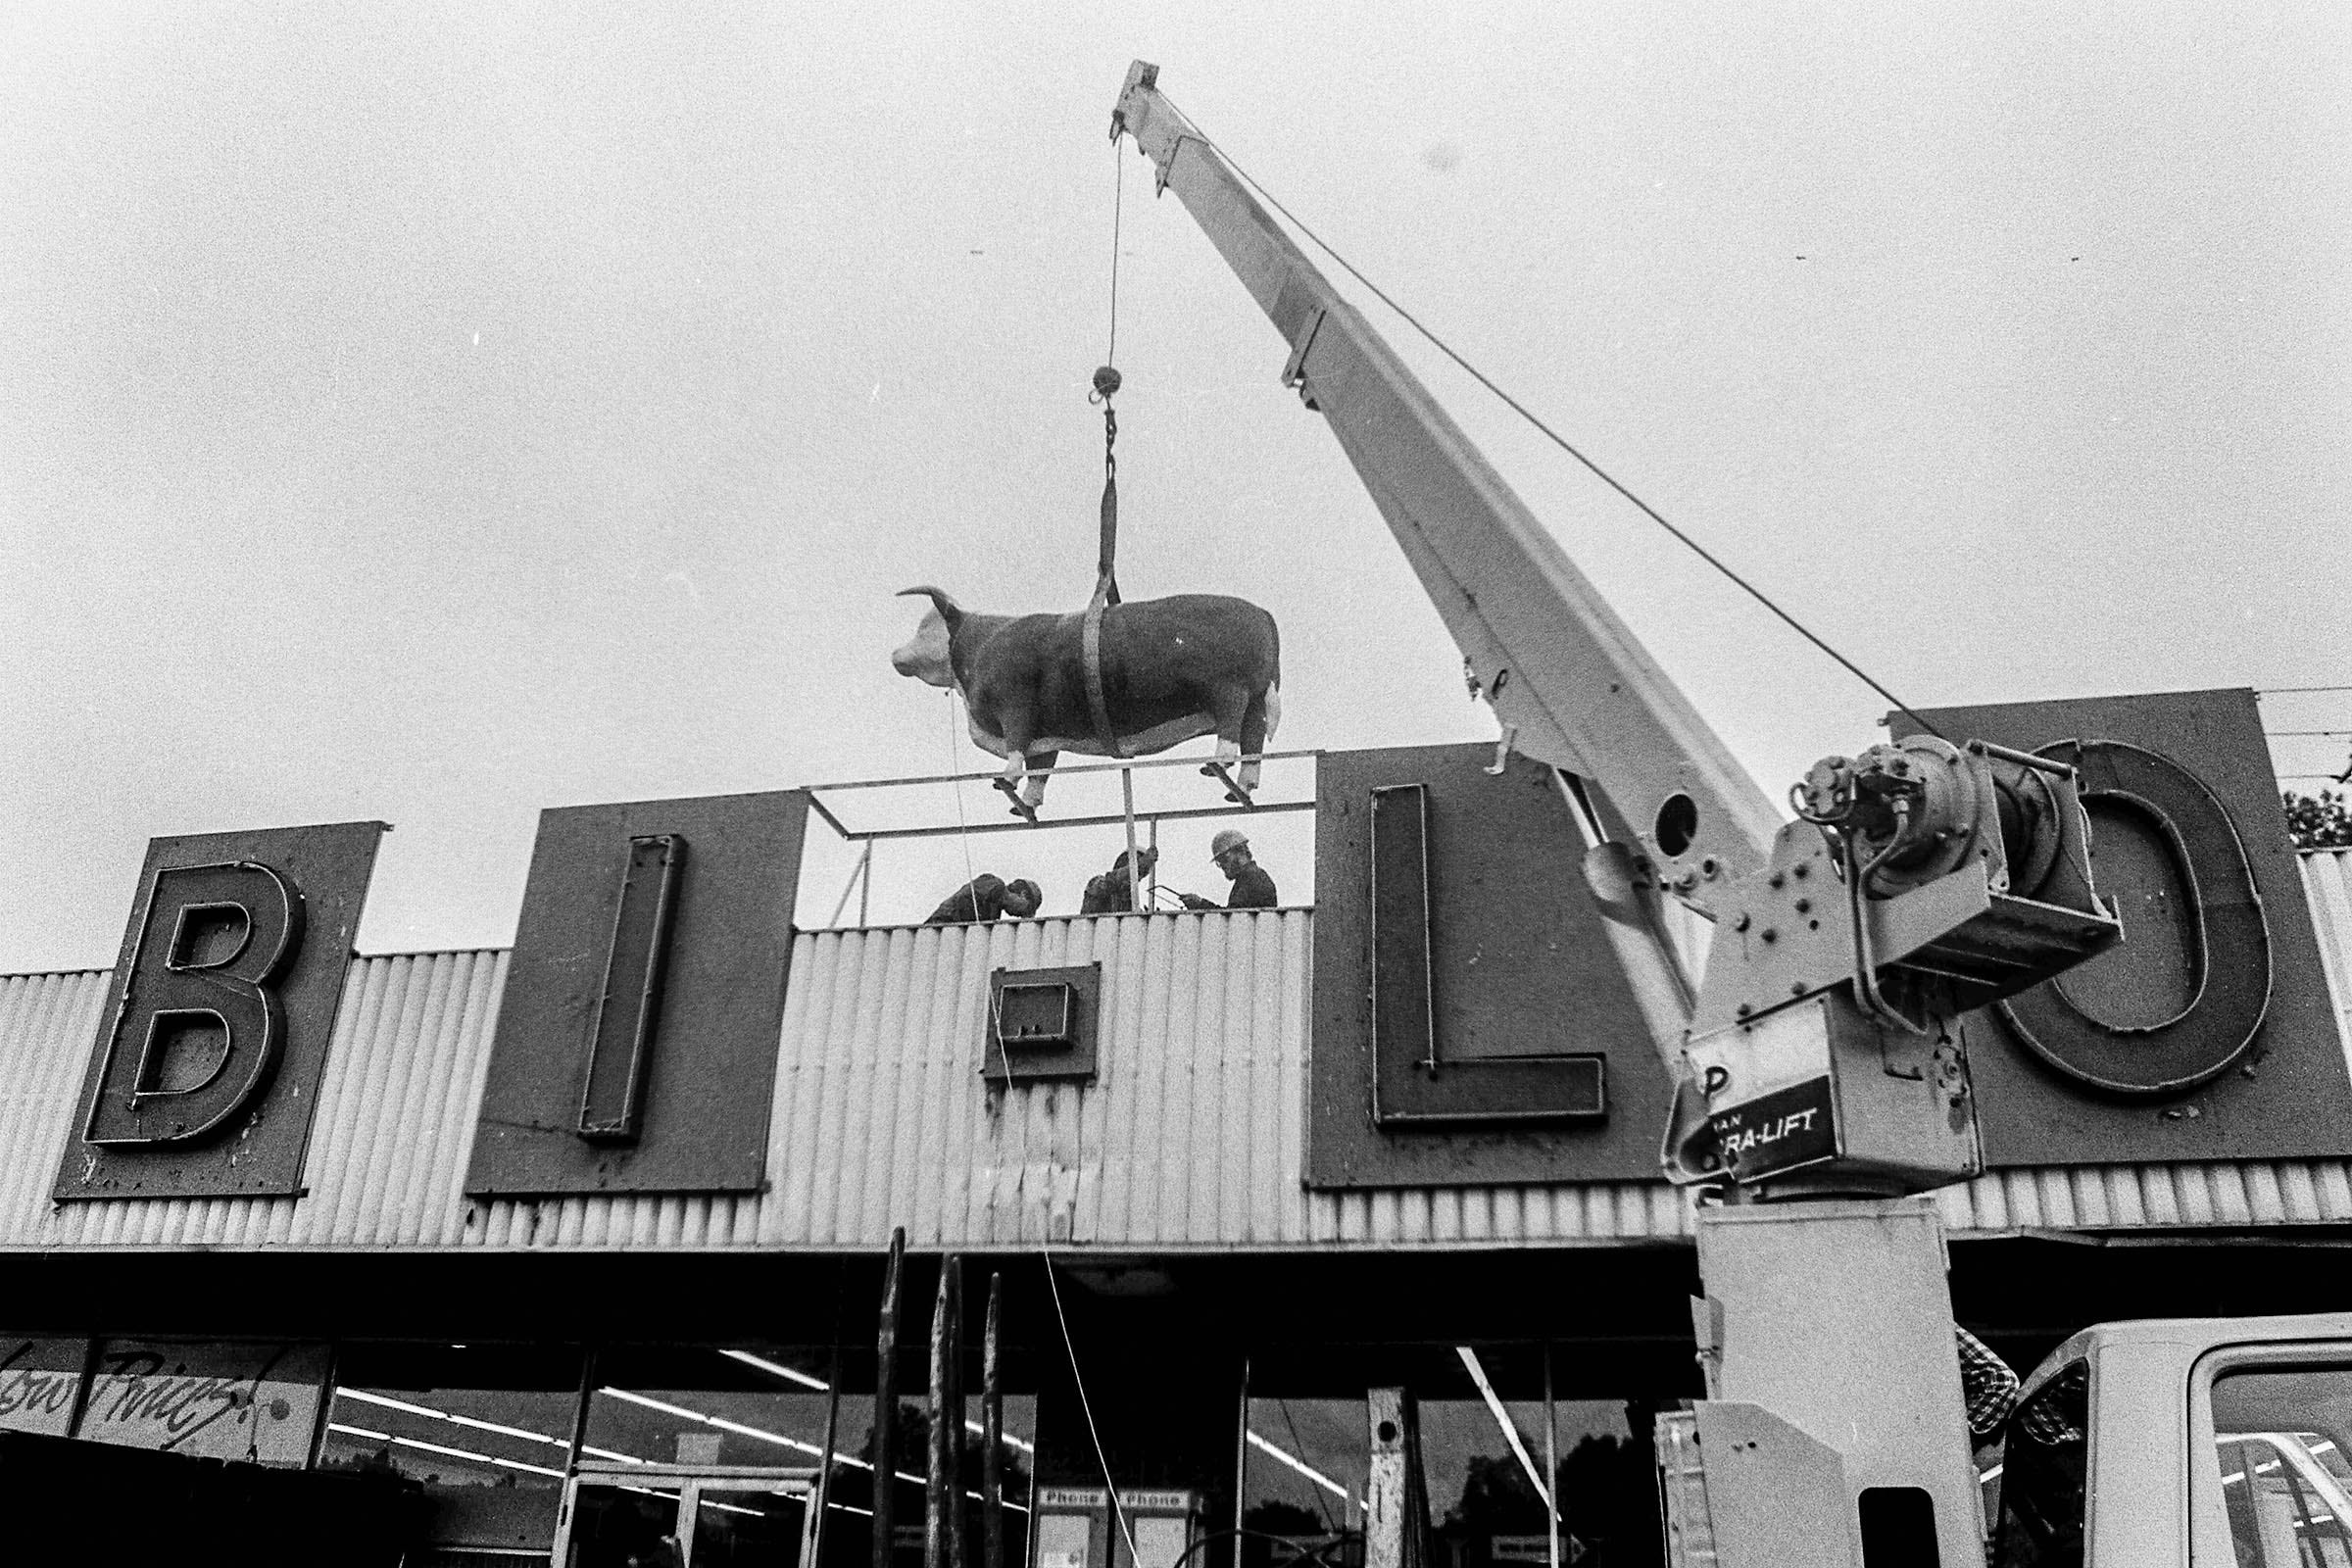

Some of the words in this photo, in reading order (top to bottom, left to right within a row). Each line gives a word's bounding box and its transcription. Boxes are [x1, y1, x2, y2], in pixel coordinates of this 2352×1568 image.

[1719, 1106, 1818, 1156] RA-LIFT
[1047, 1489, 1100, 1504] Phone
[1128, 1492, 1180, 1507] Phone
